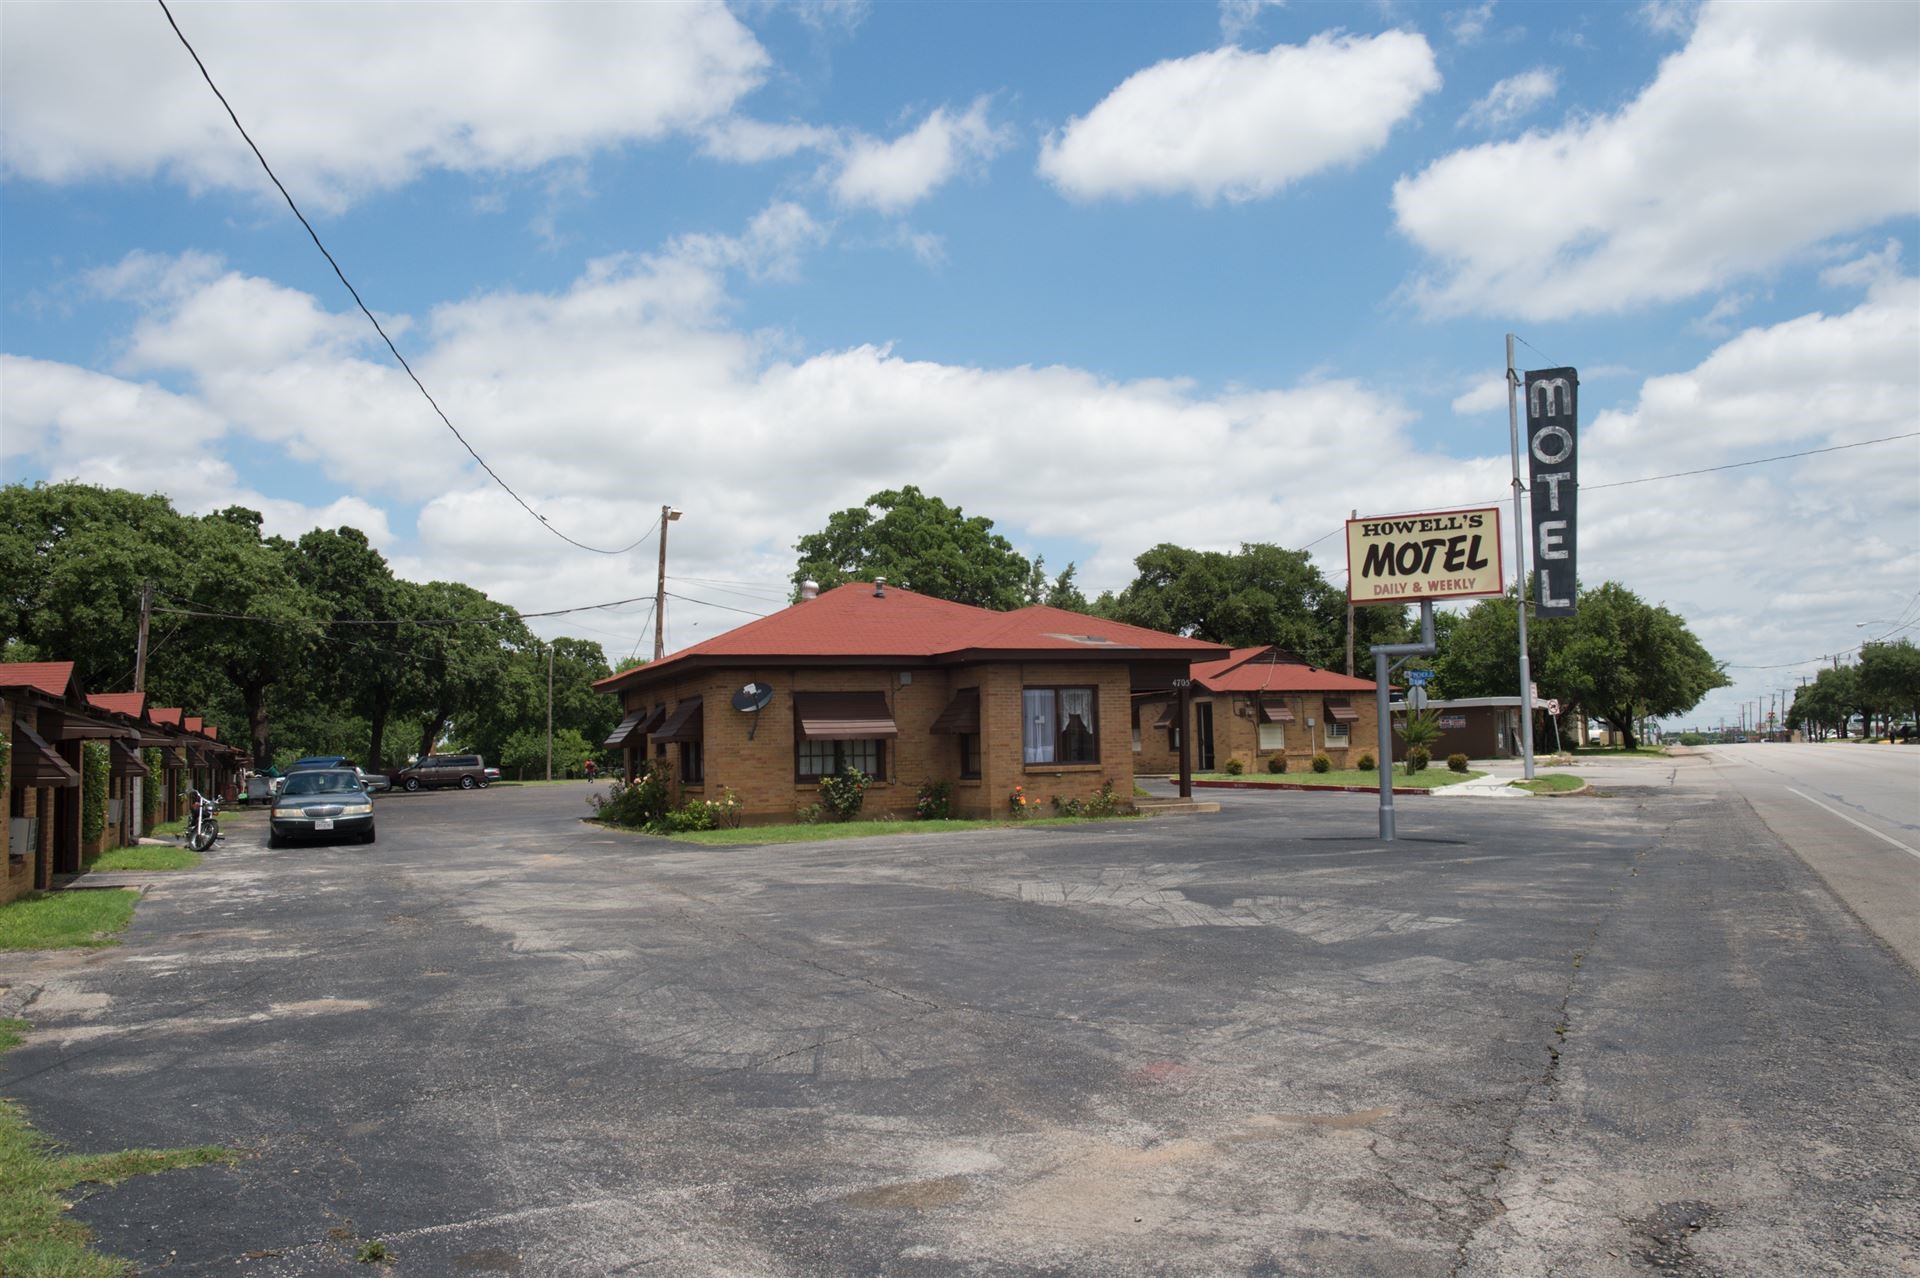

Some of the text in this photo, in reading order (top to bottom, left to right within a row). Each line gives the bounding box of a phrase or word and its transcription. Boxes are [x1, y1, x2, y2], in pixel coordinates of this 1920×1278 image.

[1530, 376, 1574, 609] MOTEL
[1362, 514, 1483, 537] HOWELL'S
[1362, 534, 1488, 578] MOTEL
[1374, 578, 1477, 596] DAILY & WEEKLY
